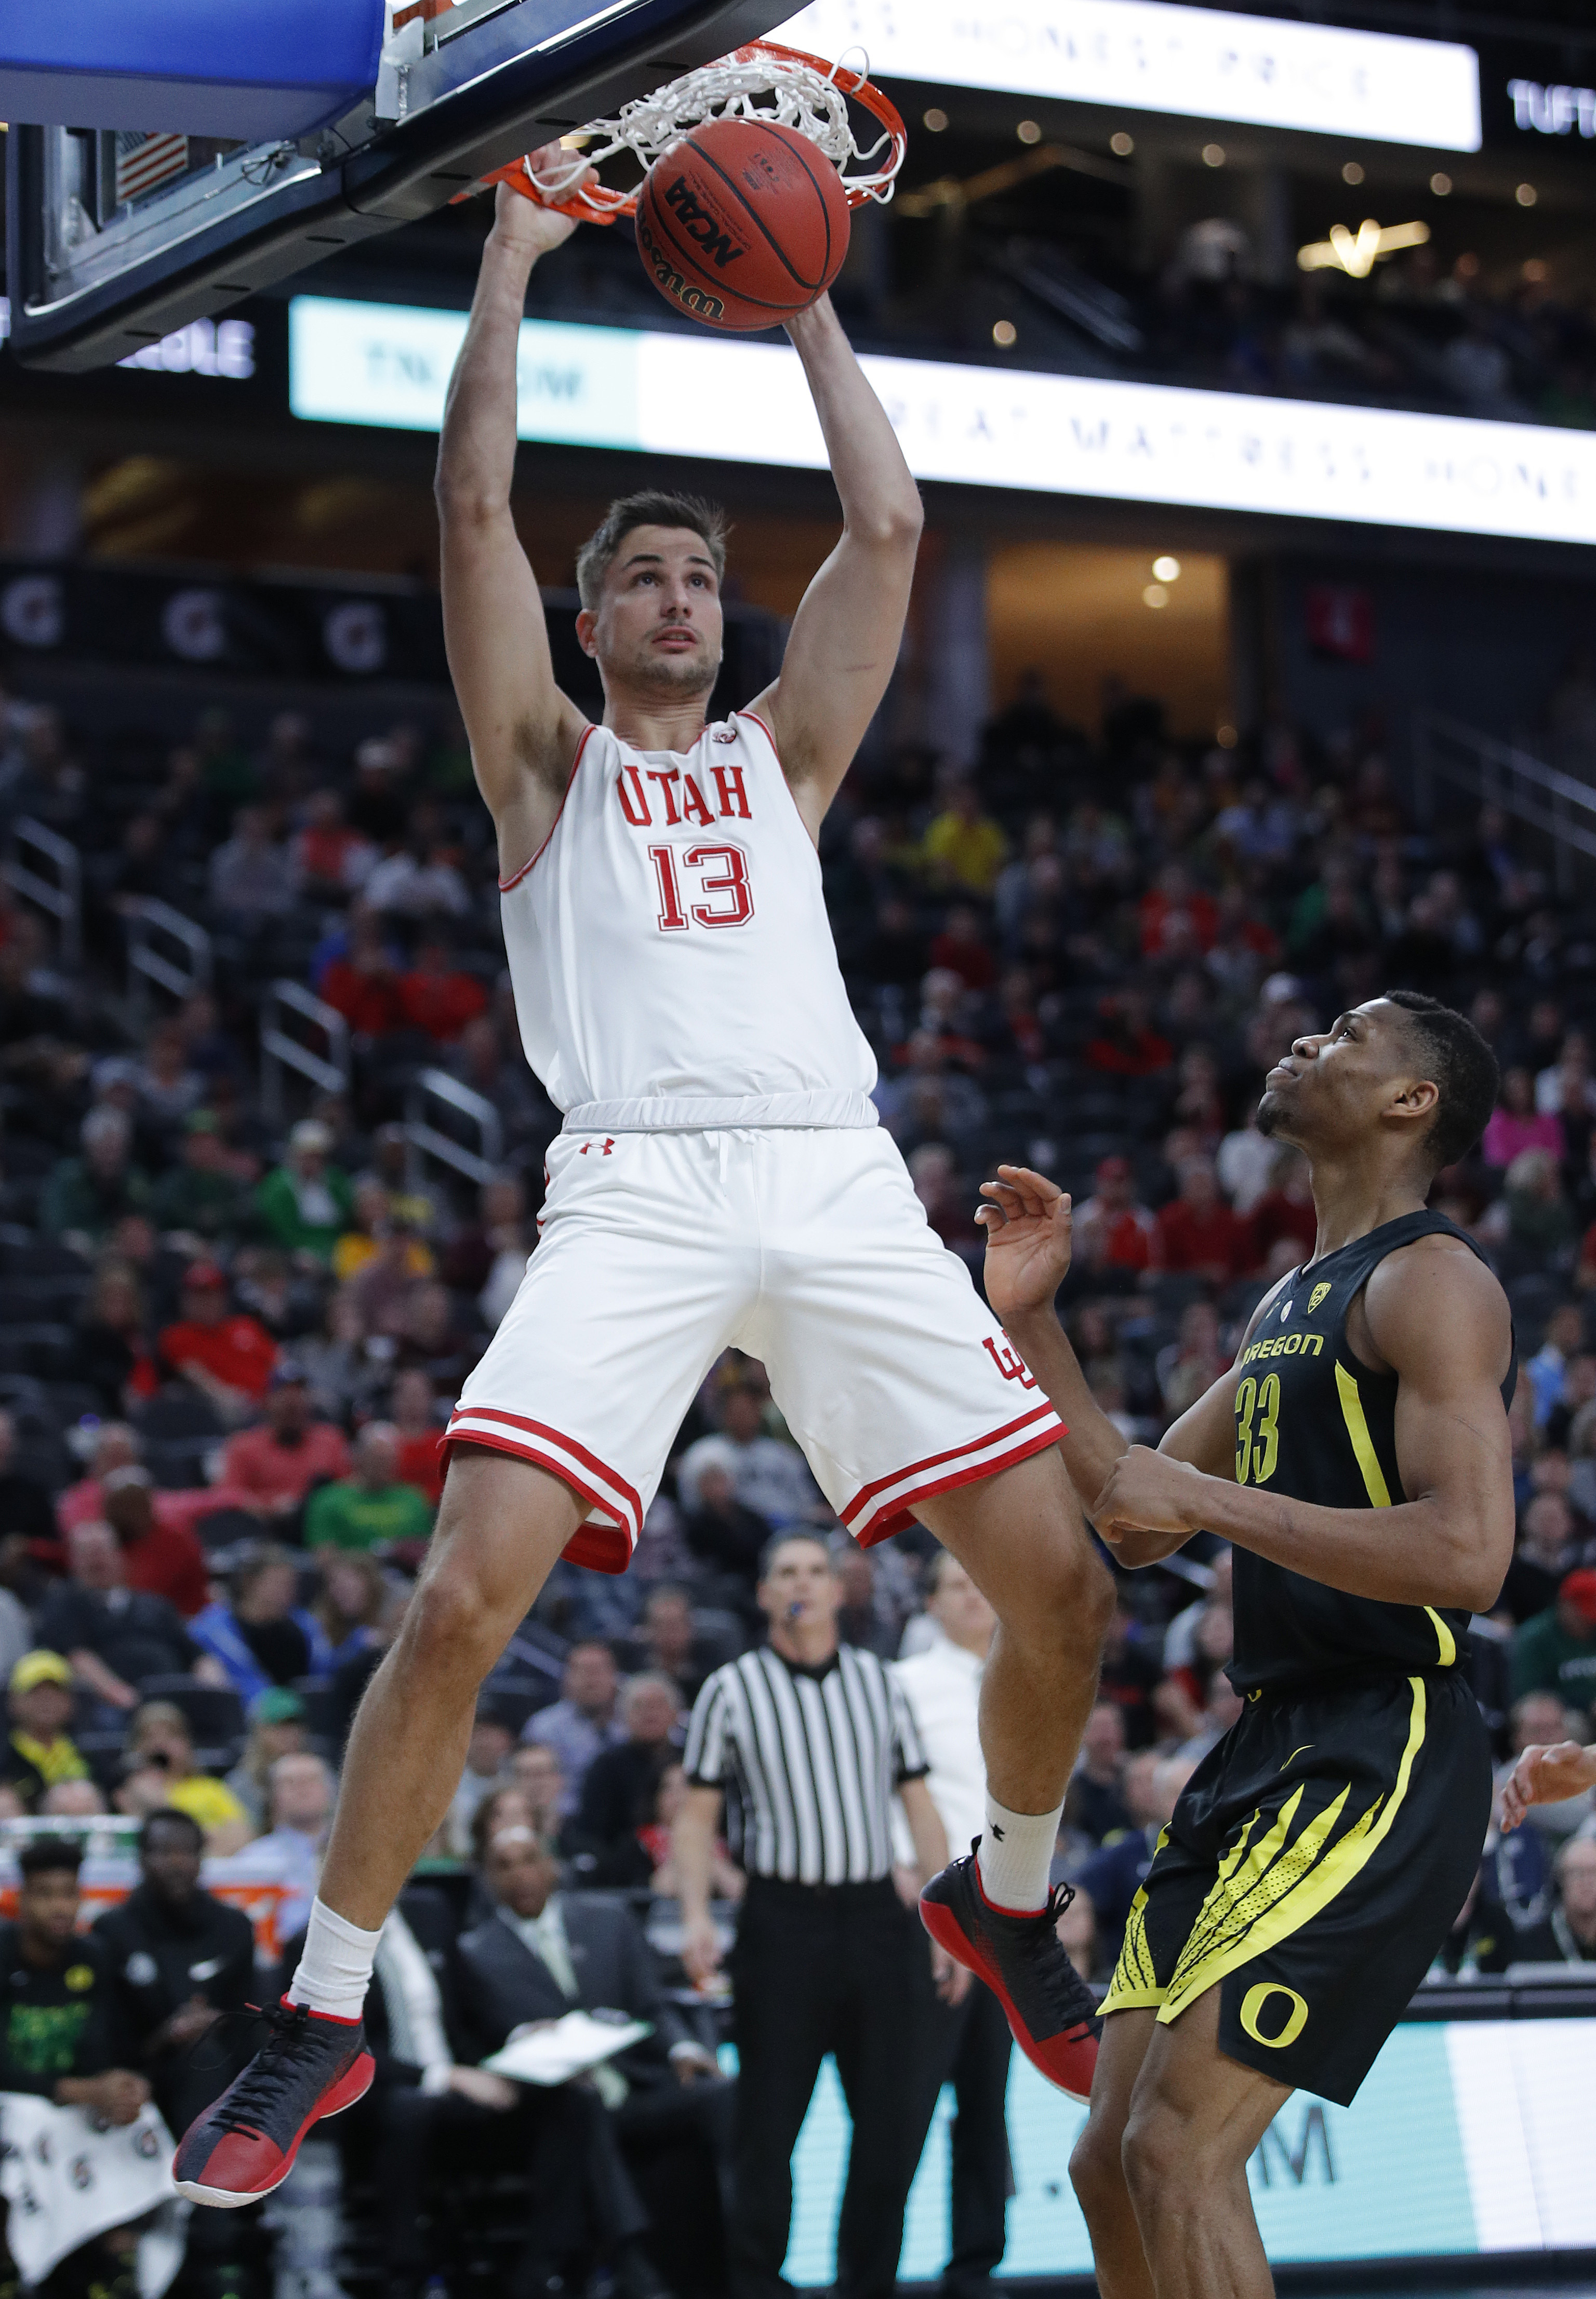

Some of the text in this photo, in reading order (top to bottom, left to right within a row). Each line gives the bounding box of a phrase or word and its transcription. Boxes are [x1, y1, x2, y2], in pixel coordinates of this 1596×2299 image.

[664, 176, 744, 268] NCAA
[885, 393, 1029, 443] REAT
[617, 766, 752, 827] UTAH
[648, 843, 755, 932] 13
[1235, 1373, 1281, 1485] 33
[1240, 1982, 1309, 2048] O
